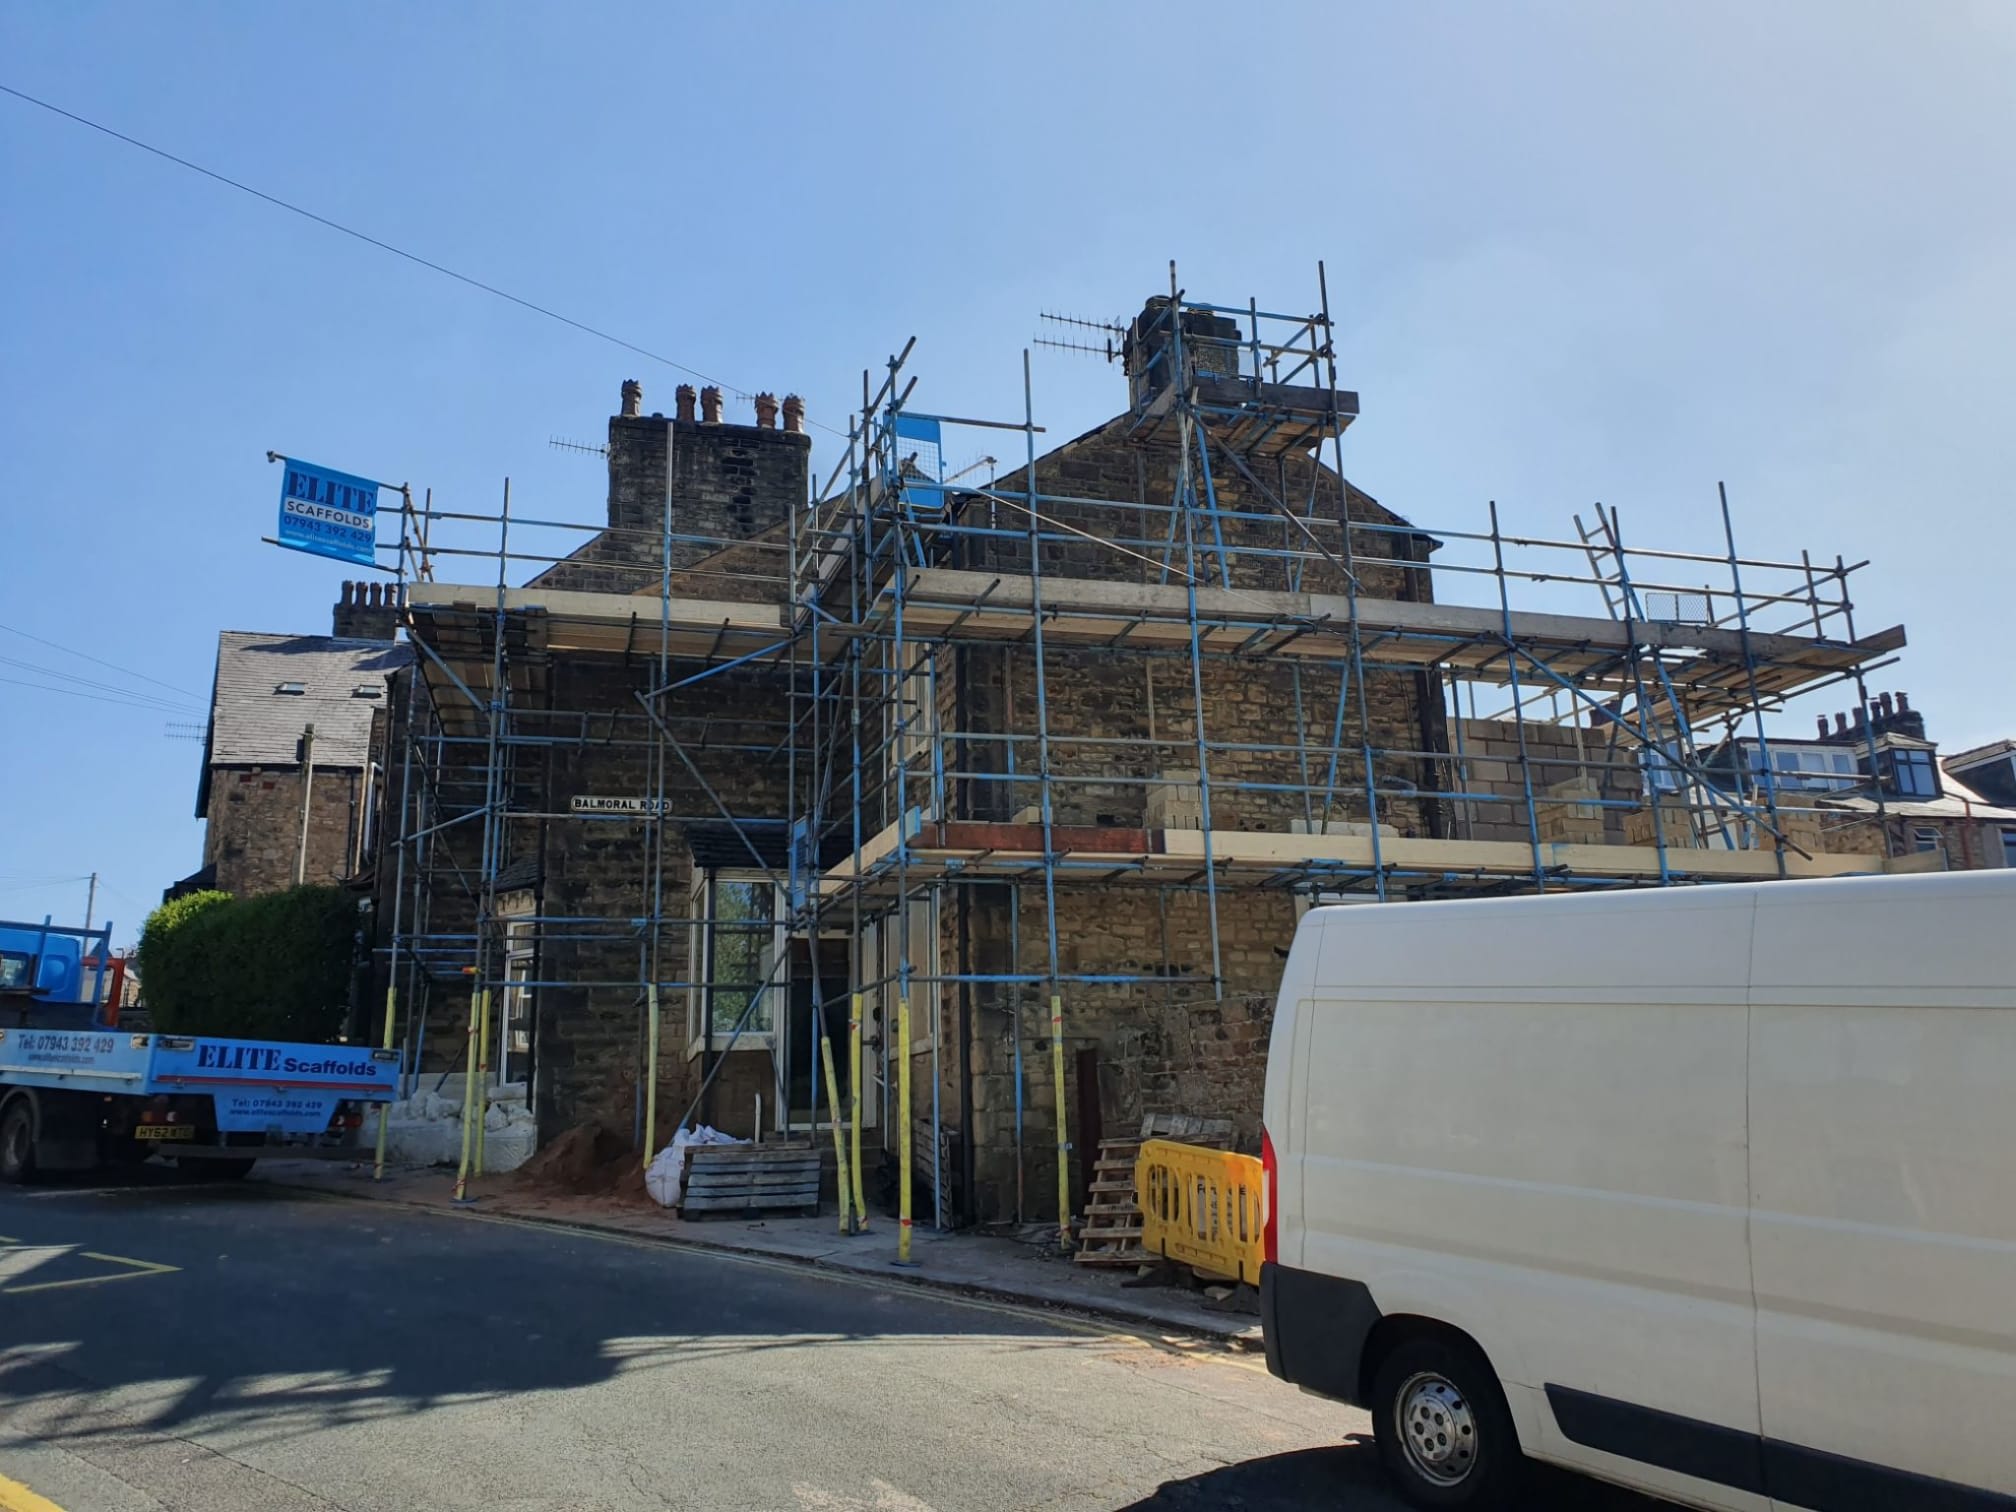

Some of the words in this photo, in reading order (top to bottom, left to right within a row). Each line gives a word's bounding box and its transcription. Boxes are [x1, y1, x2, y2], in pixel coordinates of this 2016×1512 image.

[287, 471, 375, 517] ELITE
[283, 515, 321, 532] 07943
[325, 523, 346, 537] 392
[350, 530, 372, 543] 429
[287, 501, 370, 529] SCAFFOLDS
[575, 799, 636, 809] BALMORAL
[18, 1034, 34, 1049] Tel:
[39, 1035, 68, 1052] 07943
[70, 1037, 90, 1052] 392
[94, 1037, 114, 1054] 429
[197, 1045, 281, 1071] ELITE
[284, 1057, 377, 1077] Scaffolds
[232, 1098, 250, 1107] Tel:
